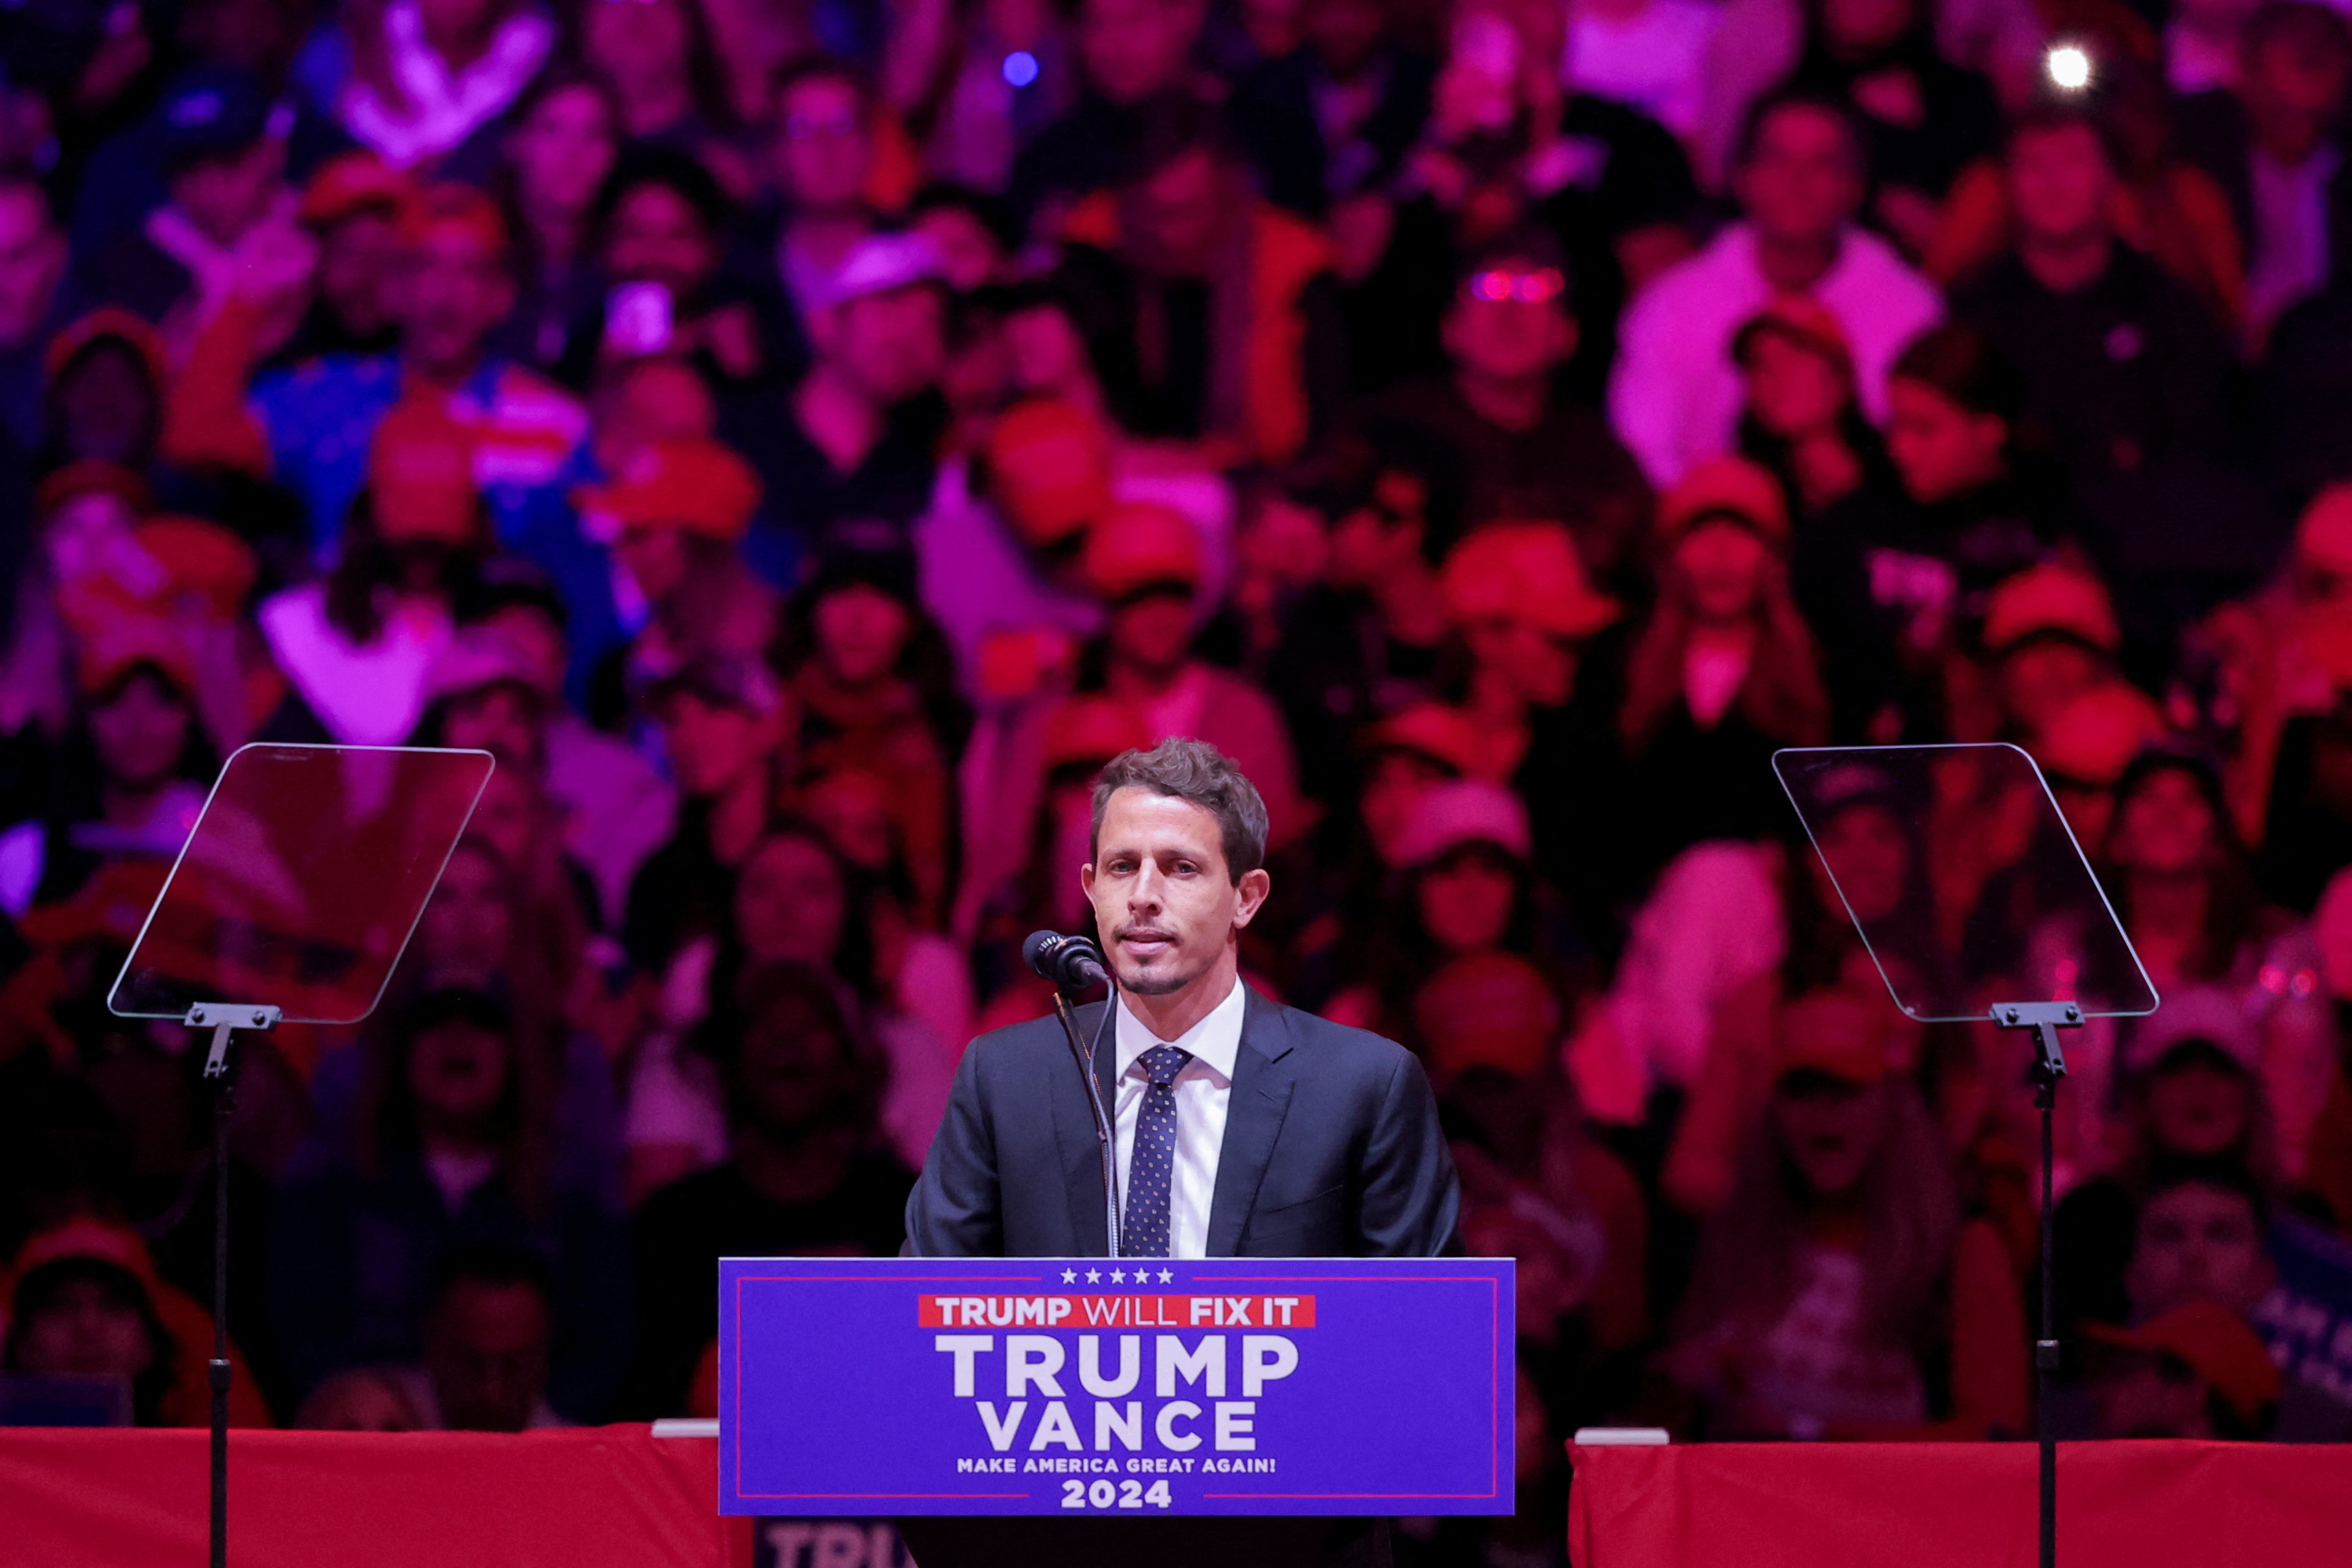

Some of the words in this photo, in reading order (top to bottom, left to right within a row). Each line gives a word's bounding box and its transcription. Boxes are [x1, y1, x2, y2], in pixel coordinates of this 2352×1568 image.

[934, 1297, 1072, 1327] TRUMP
[1081, 1297, 1178, 1327] WILL
[1190, 1297, 1253, 1327] FIX
[1262, 1297, 1299, 1327] IT
[934, 1334, 1300, 1398] TRUMP
[975, 1400, 1257, 1453] VANCE
[957, 1458, 1017, 1474] MAKE
[1023, 1458, 1120, 1474] AMERICA
[1126, 1458, 1195, 1474] GREAT
[1201, 1458, 1277, 1474] AGAIN!
[1061, 1478, 1172, 1509] 2024
